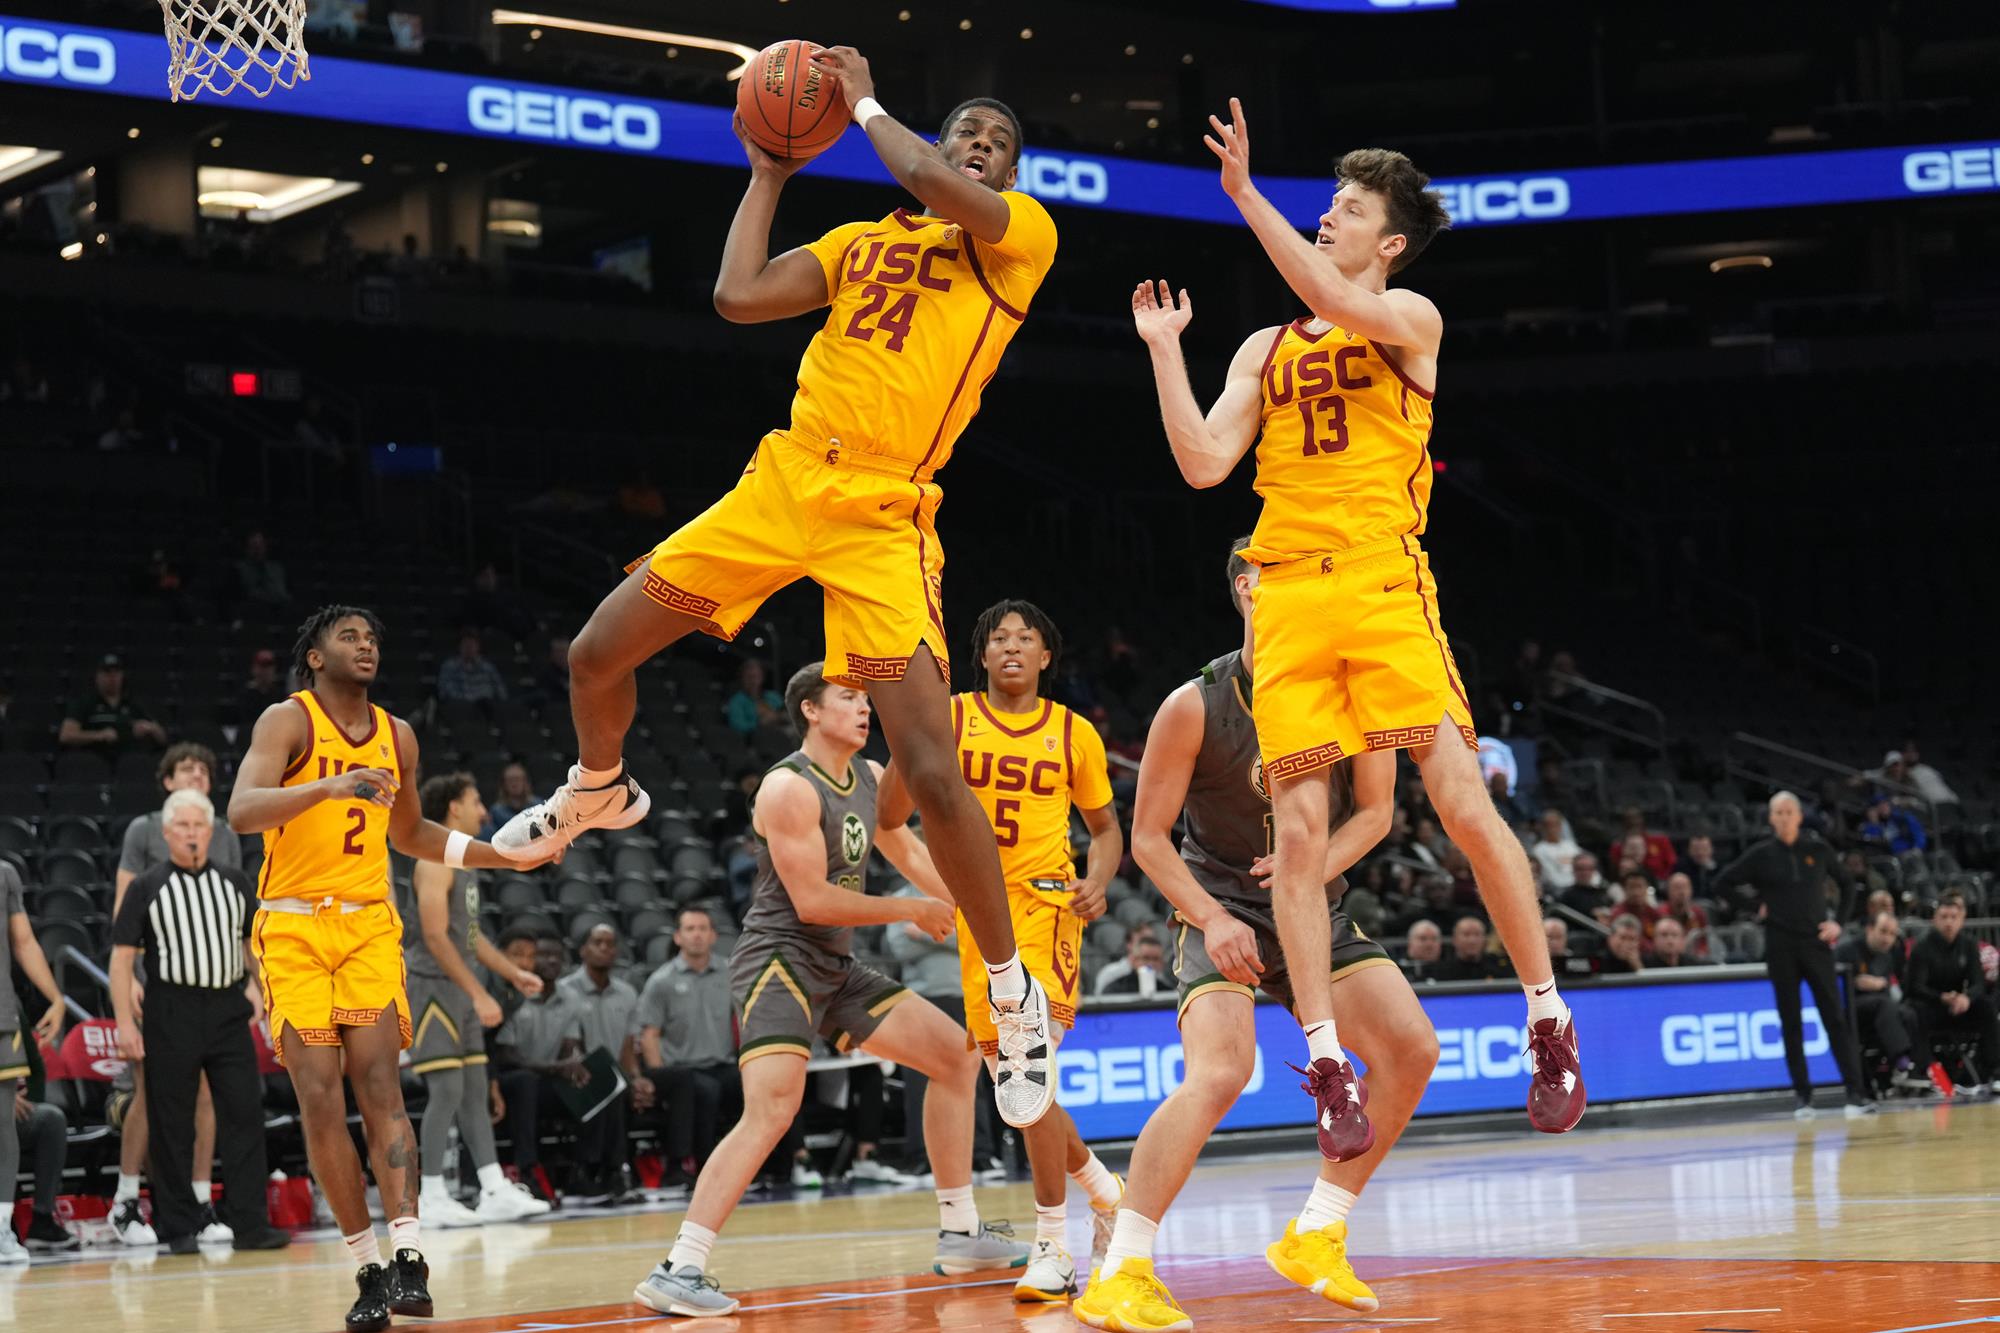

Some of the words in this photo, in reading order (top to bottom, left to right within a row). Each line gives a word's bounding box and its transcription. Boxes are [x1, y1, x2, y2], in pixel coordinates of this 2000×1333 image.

[467, 85, 661, 151] GEICO
[847, 242, 959, 292] USC
[845, 285, 919, 353] 24
[1267, 346, 1372, 407] USC
[1298, 394, 1349, 456] 13
[969, 716, 978, 728] C
[962, 749, 1061, 796] USC
[343, 807, 366, 855] 2
[995, 798, 1020, 848] 5
[1430, 1024, 1533, 1082] EIC
